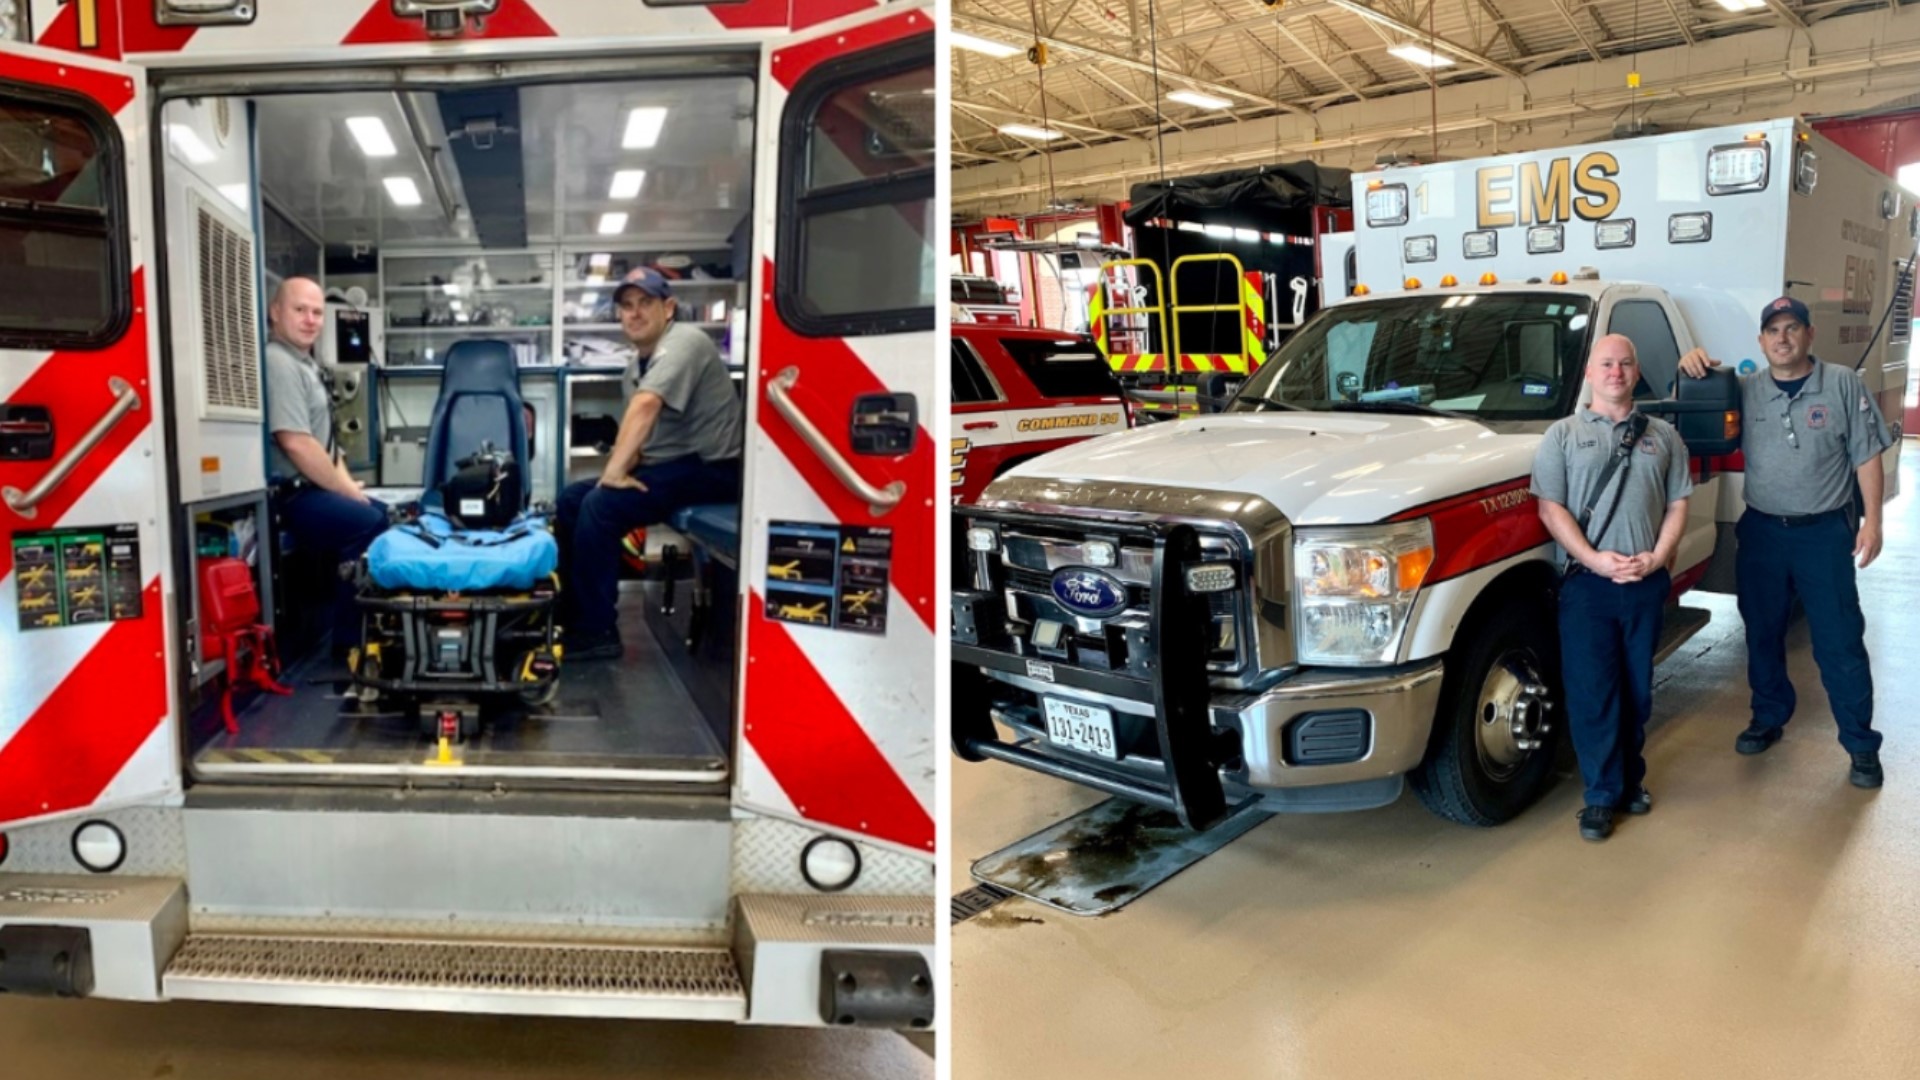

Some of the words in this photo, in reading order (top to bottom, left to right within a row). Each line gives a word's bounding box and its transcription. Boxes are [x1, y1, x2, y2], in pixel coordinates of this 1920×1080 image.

[1414, 180, 1429, 215] 1
[1476, 151, 1621, 229] EMS
[1017, 413, 1098, 432] COMMAND
[1100, 412, 1119, 425] 54
[1479, 497, 1498, 514] TX
[1064, 578, 1102, 605] Ford
[1063, 704, 1090, 719] TEXAS
